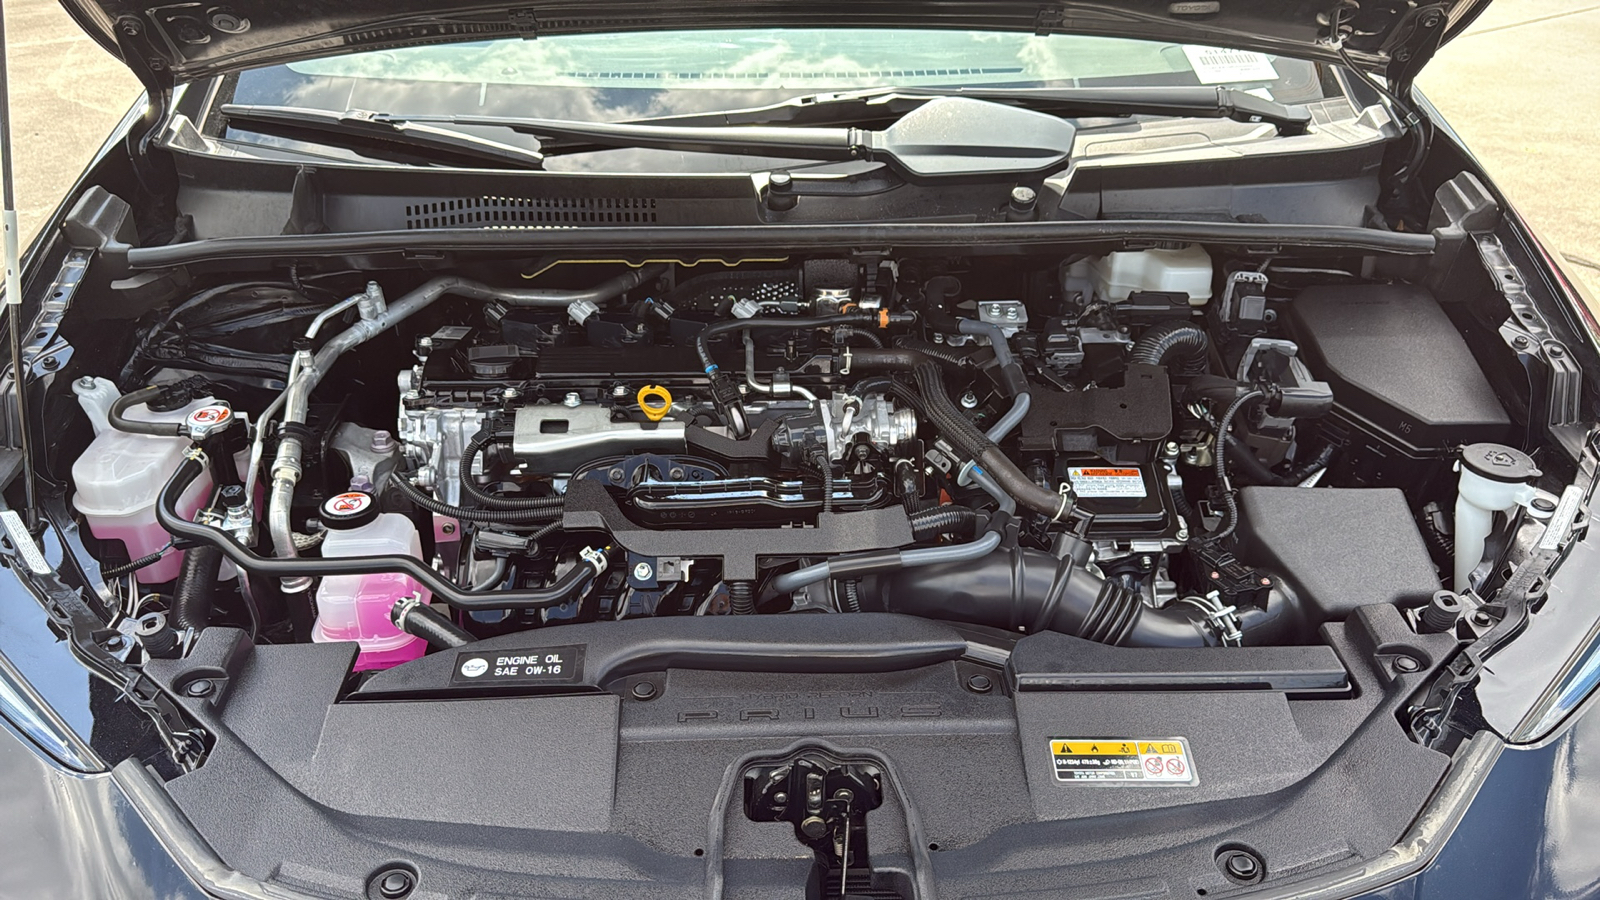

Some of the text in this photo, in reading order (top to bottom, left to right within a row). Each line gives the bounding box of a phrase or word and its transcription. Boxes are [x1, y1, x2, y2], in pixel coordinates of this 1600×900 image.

[496, 654, 563, 666] ENGINE OIL
[494, 665, 561, 676] SAE 0W-16
[677, 705, 943, 722] PRIUS
